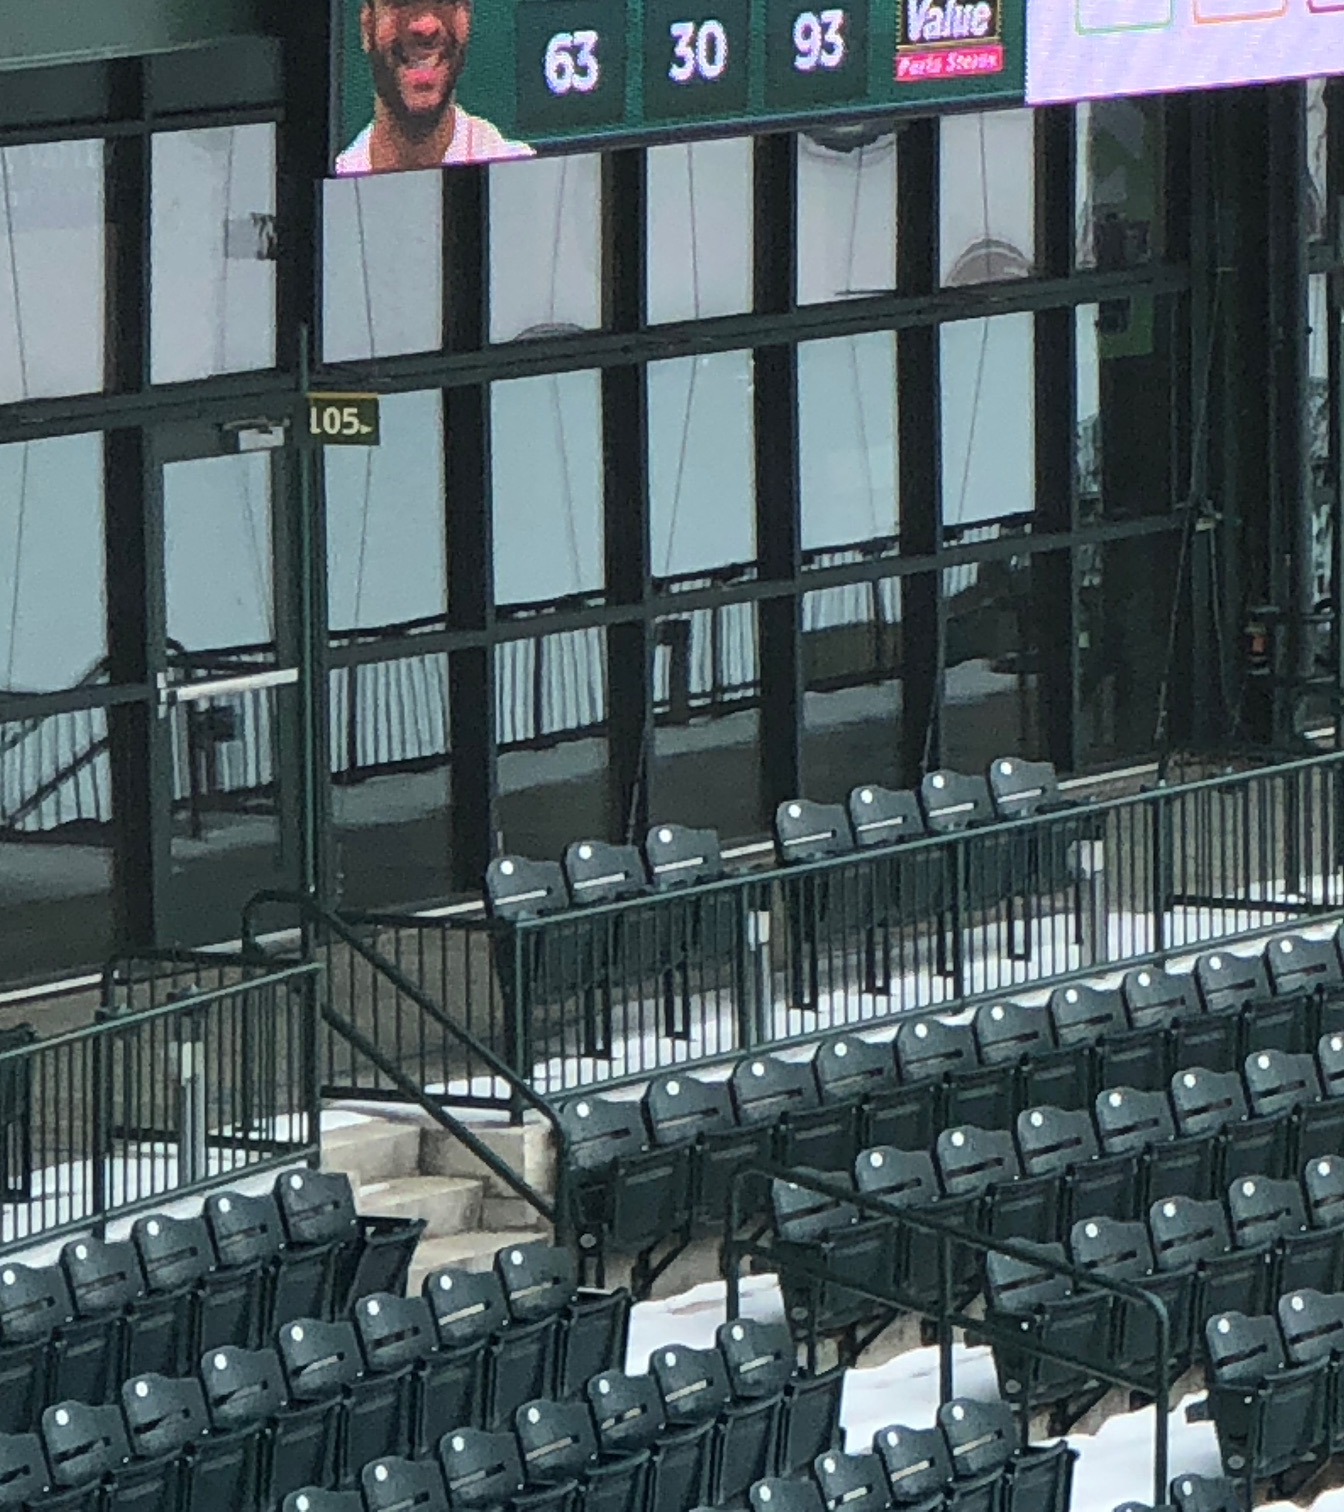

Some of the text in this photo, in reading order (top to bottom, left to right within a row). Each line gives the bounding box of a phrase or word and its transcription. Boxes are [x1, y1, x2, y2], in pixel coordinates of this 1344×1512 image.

[543, 8, 846, 94] 63 30 93
[310, 406, 359, 435] 105
